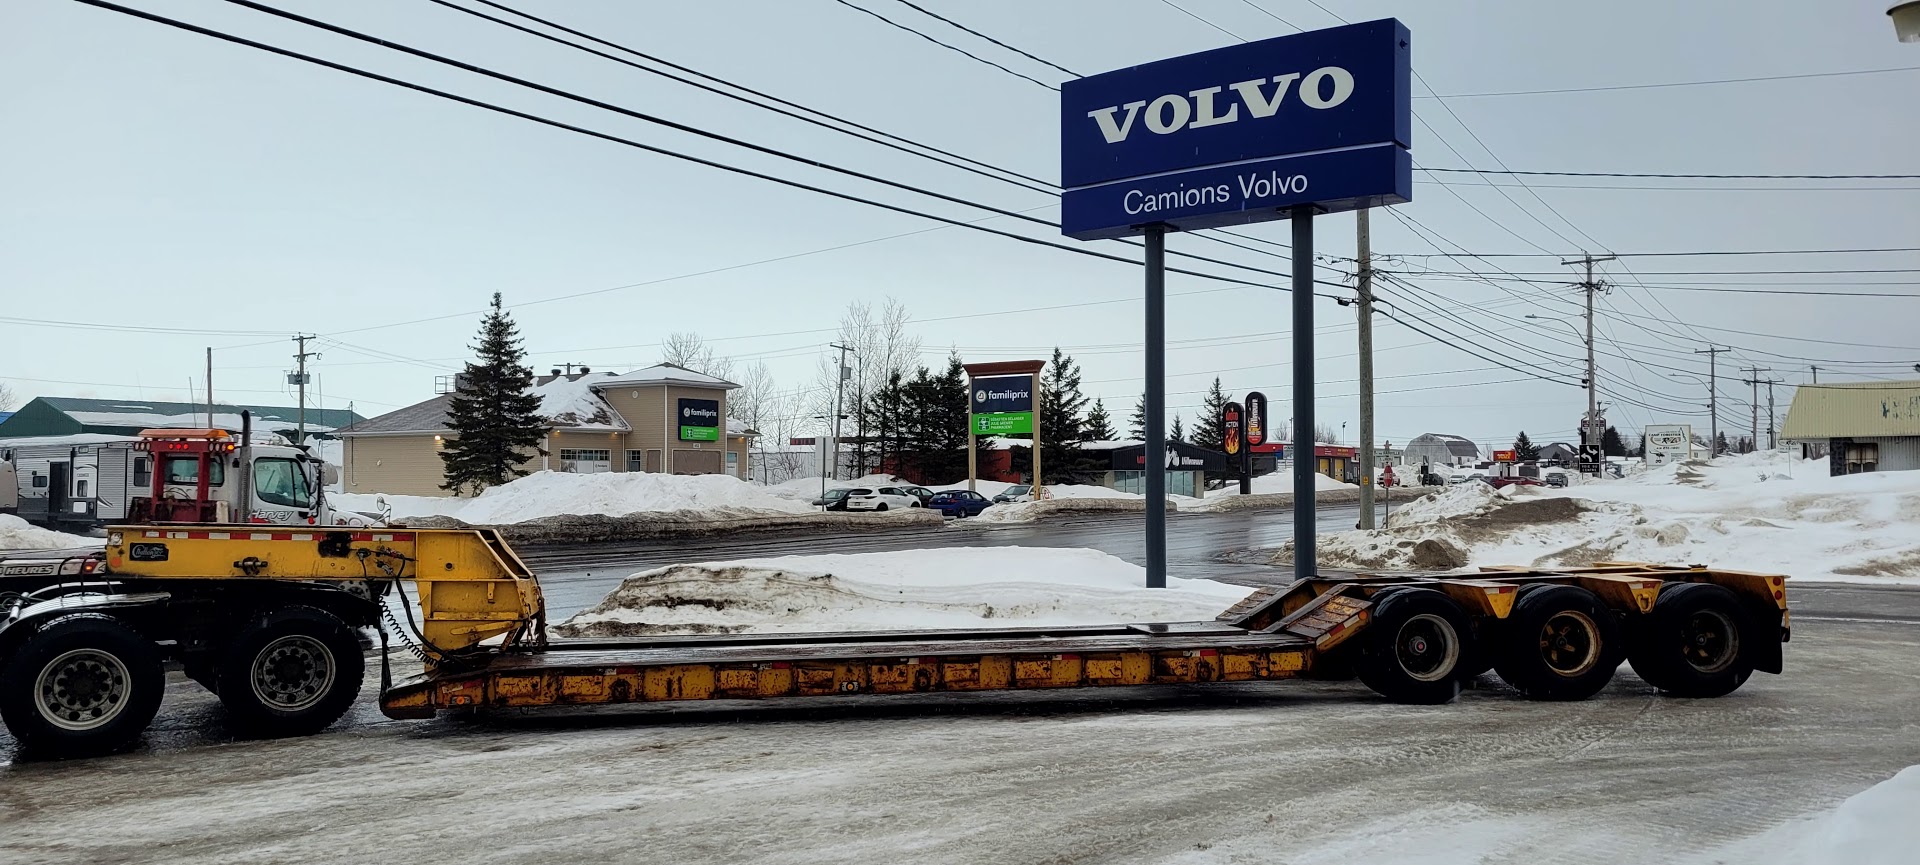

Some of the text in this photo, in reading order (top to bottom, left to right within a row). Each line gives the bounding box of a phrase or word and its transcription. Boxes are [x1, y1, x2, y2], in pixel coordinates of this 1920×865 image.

[1088, 66, 1354, 144] VOLVO
[1124, 171, 1308, 215] Camions Volvo
[988, 390, 1028, 401] familiprix
[691, 408, 717, 418] familiprix
[250, 508, 293, 522] Harvey
[4, 564, 54, 576] HEURES
